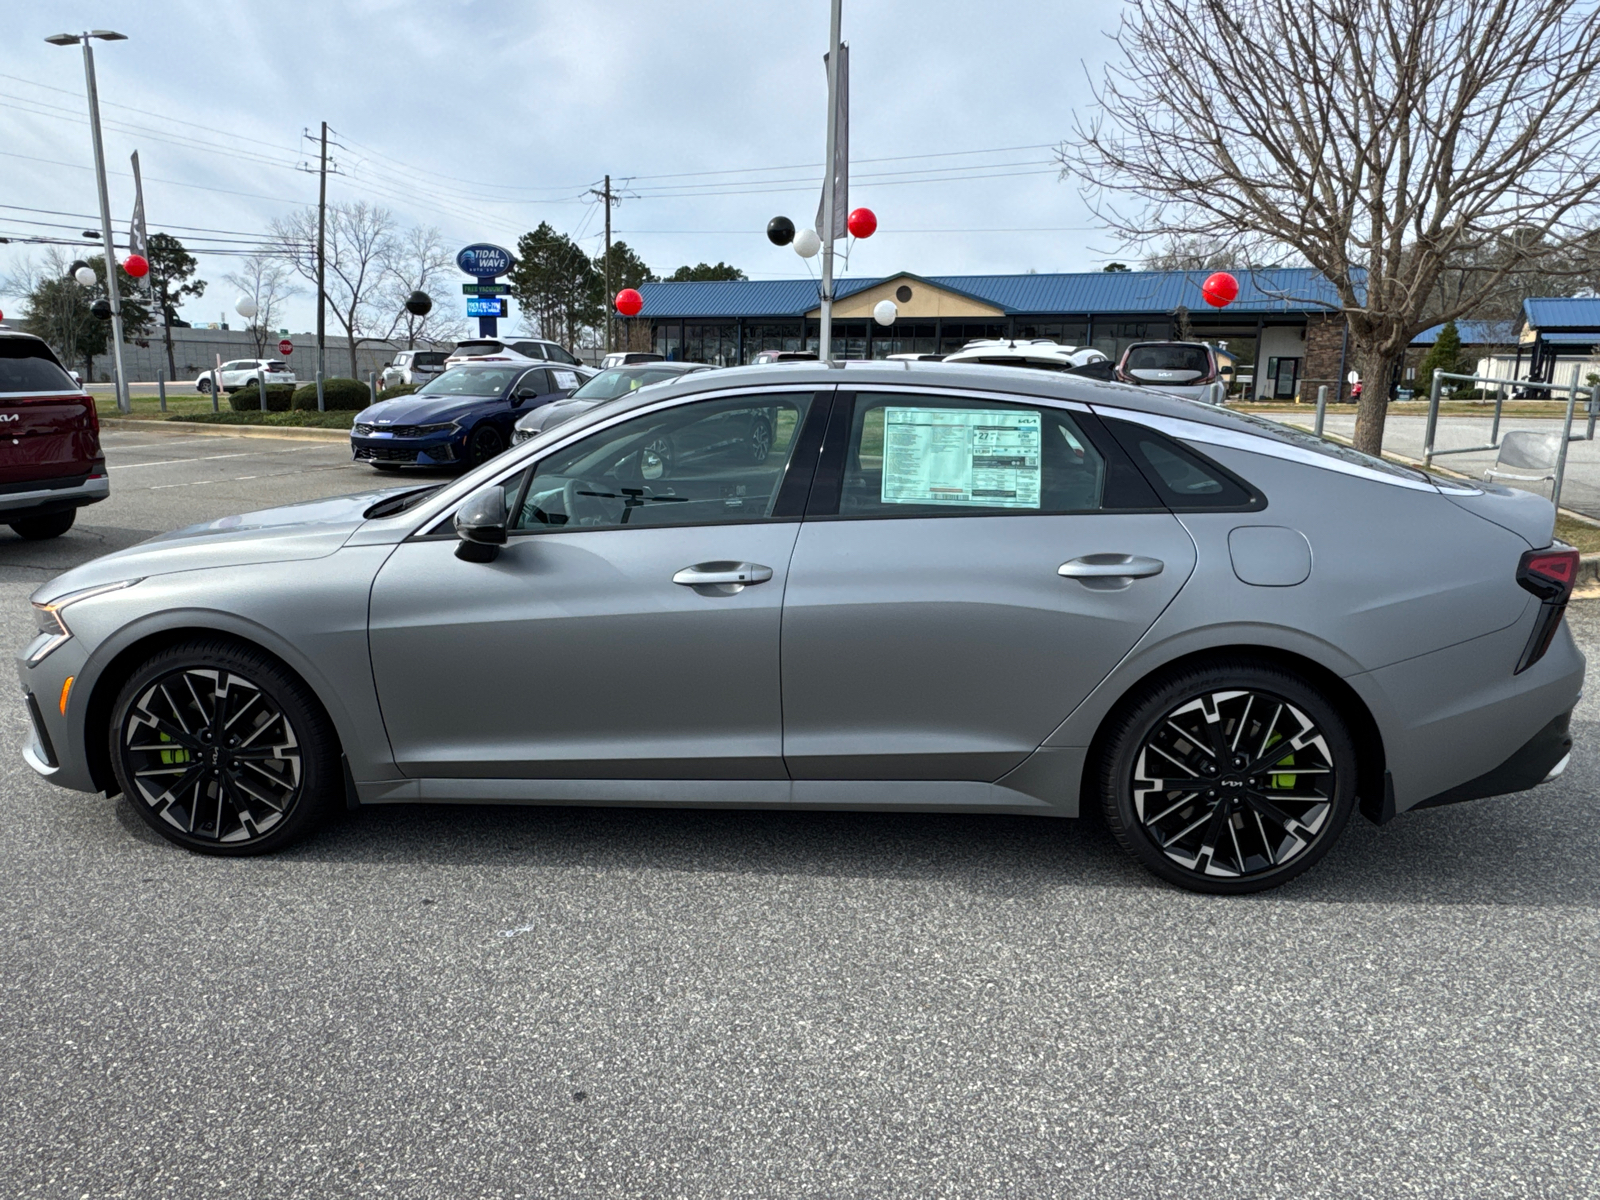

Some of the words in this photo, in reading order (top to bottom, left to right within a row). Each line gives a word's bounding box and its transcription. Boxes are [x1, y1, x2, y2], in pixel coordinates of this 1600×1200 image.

[475, 250, 500, 259] TIDAL
[479, 259, 505, 267] WAVE
[280, 344, 292, 352] STOP
[978, 432, 989, 440] 27
